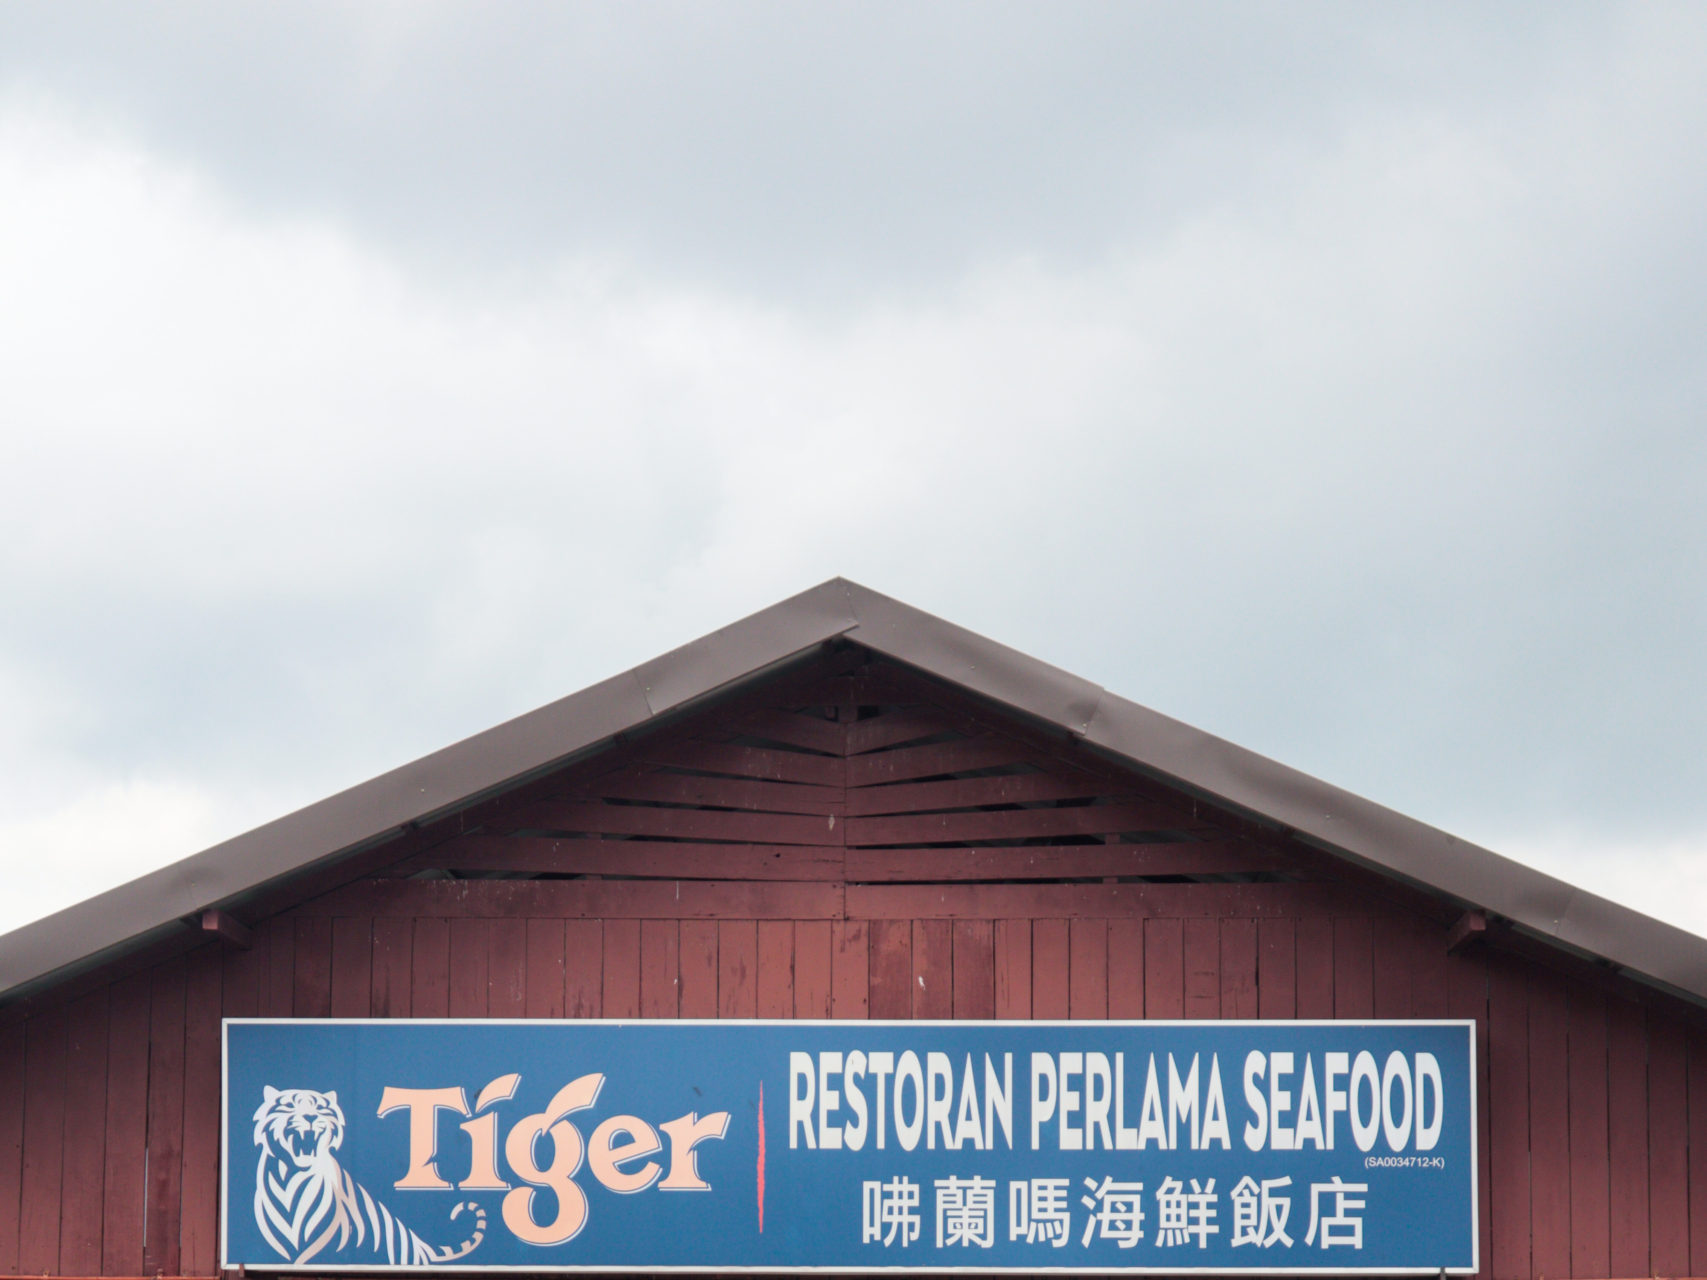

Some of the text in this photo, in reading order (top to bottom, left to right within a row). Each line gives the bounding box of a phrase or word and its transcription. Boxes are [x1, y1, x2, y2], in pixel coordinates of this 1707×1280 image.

[789, 1049, 1444, 1152] RESTORAN PERLAMA SEAFOOD
[376, 1072, 732, 1247] Tiger
[1364, 1156, 1446, 1169] (SA0034712-K)
[862, 1175, 1369, 1250] 咈蘭嗎海鮮飯店
